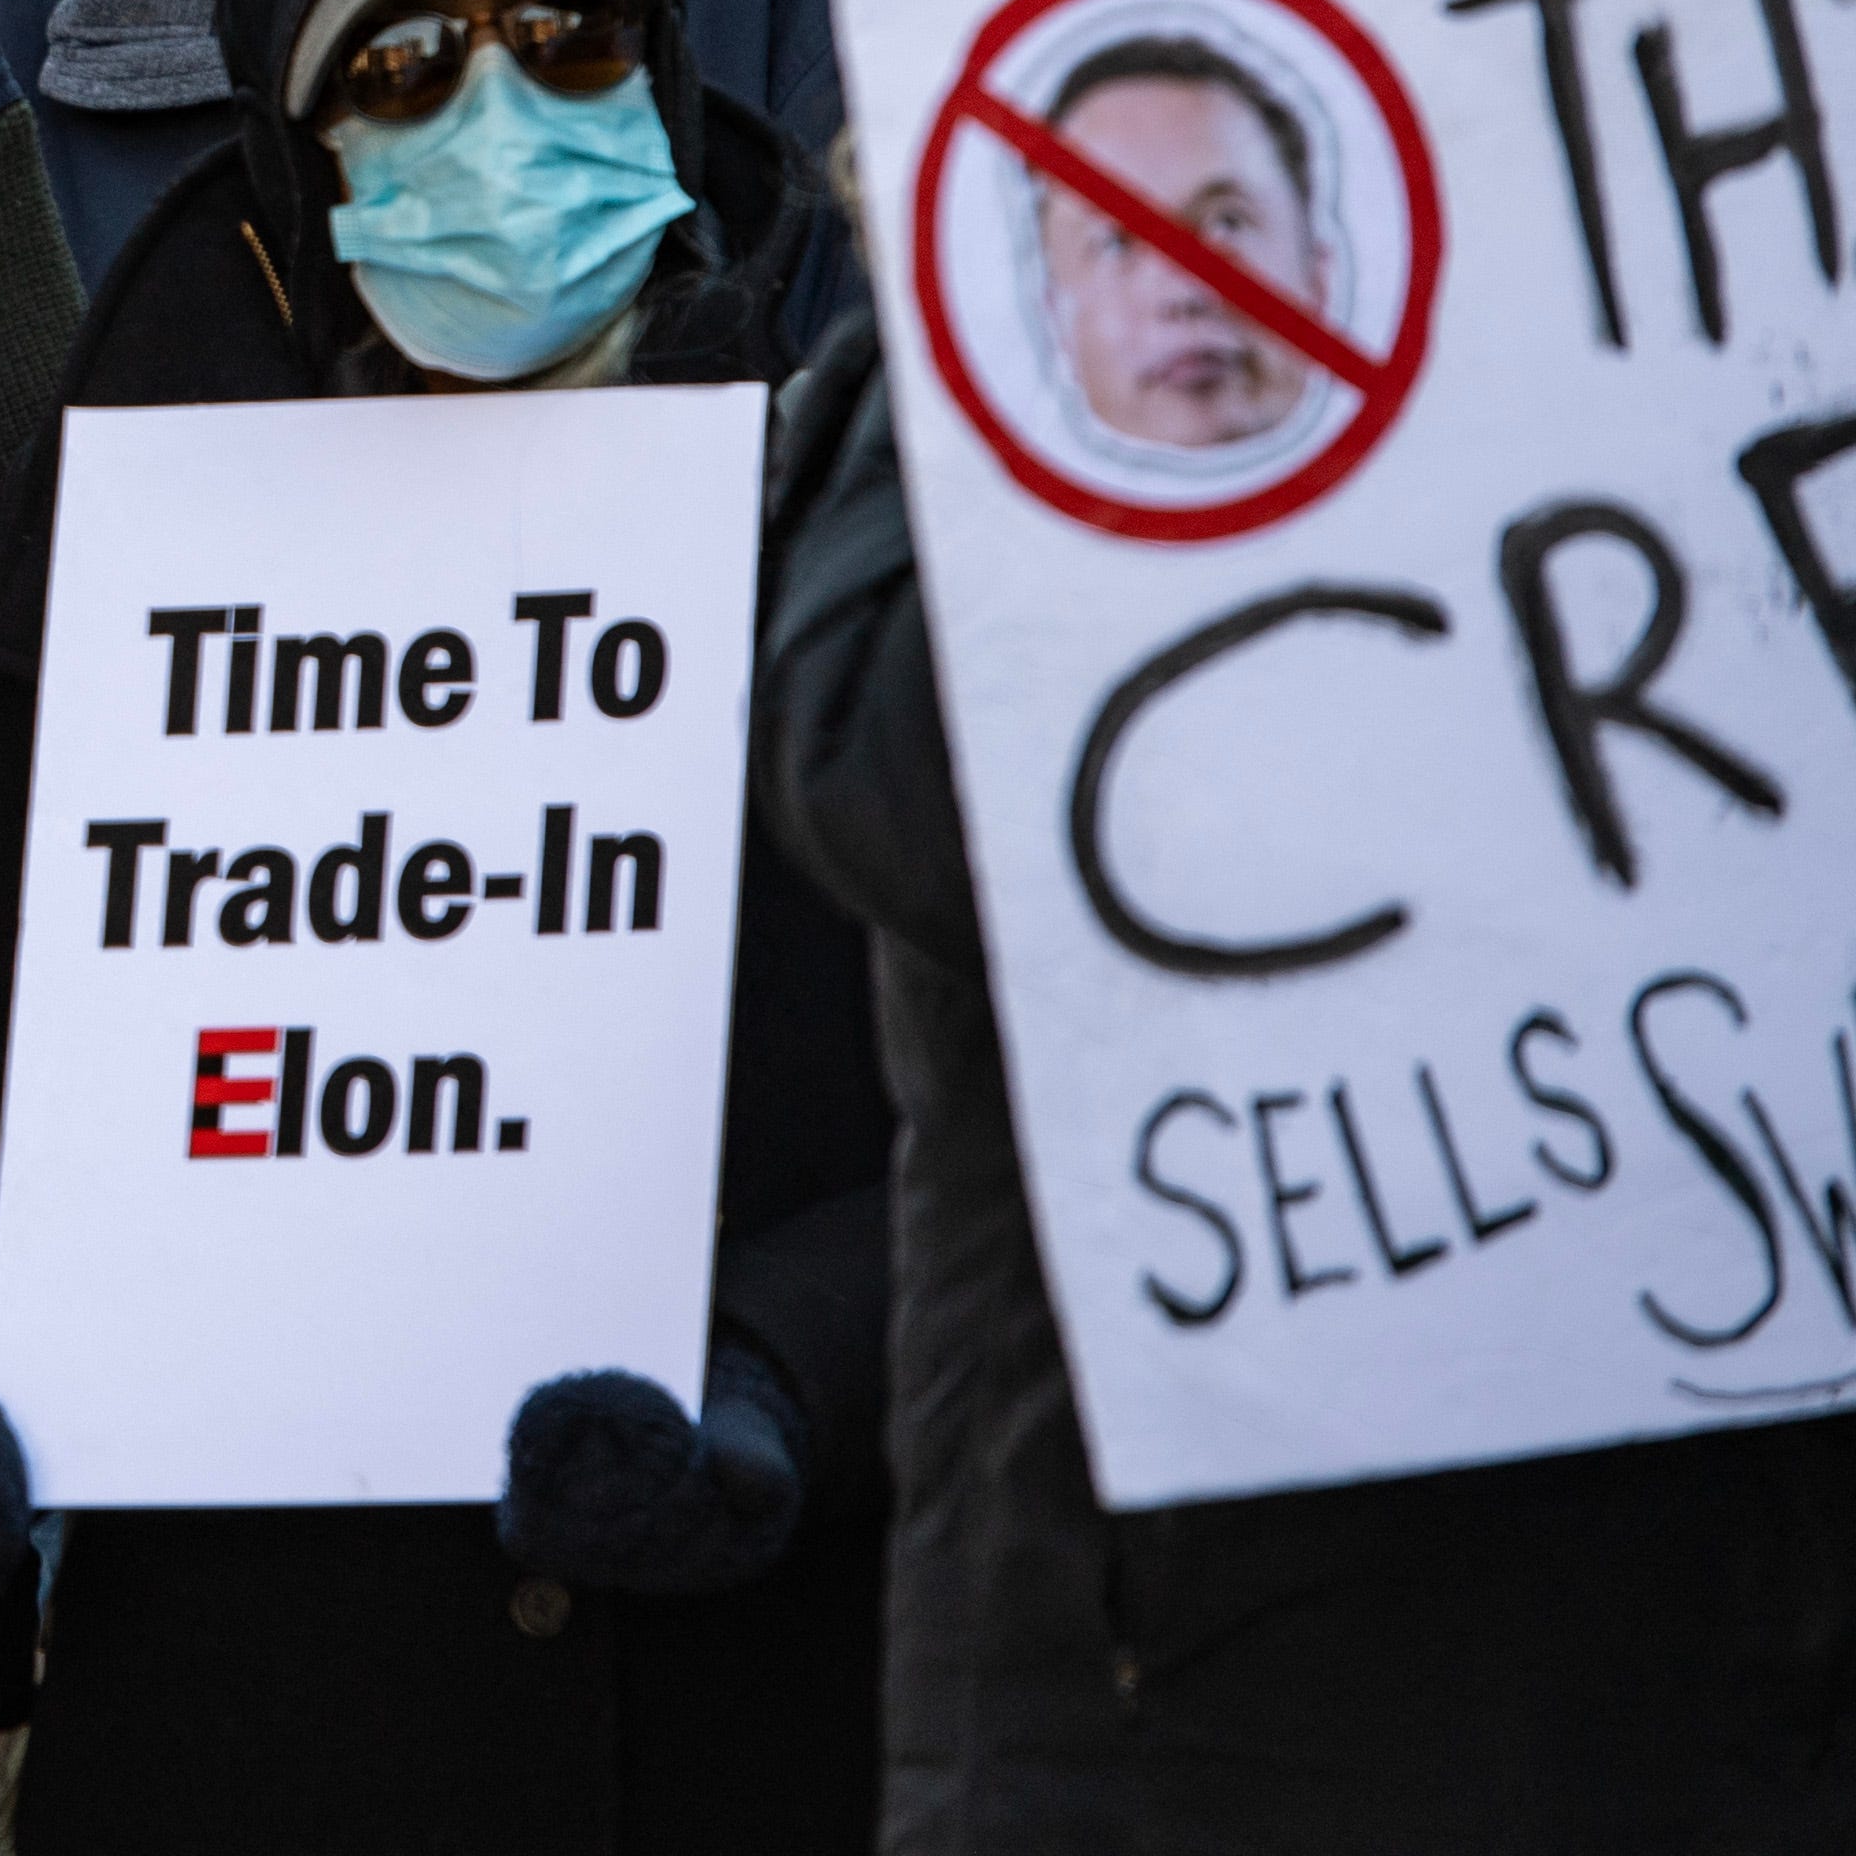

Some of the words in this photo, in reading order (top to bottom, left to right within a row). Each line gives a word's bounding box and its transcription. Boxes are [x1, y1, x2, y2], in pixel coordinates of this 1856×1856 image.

[146, 604, 479, 738] Time
[512, 590, 669, 723] To
[83, 803, 665, 950] Trade-In
[185, 1026, 531, 1160] Elon.
[1134, 1004, 1616, 1332] SELLS
